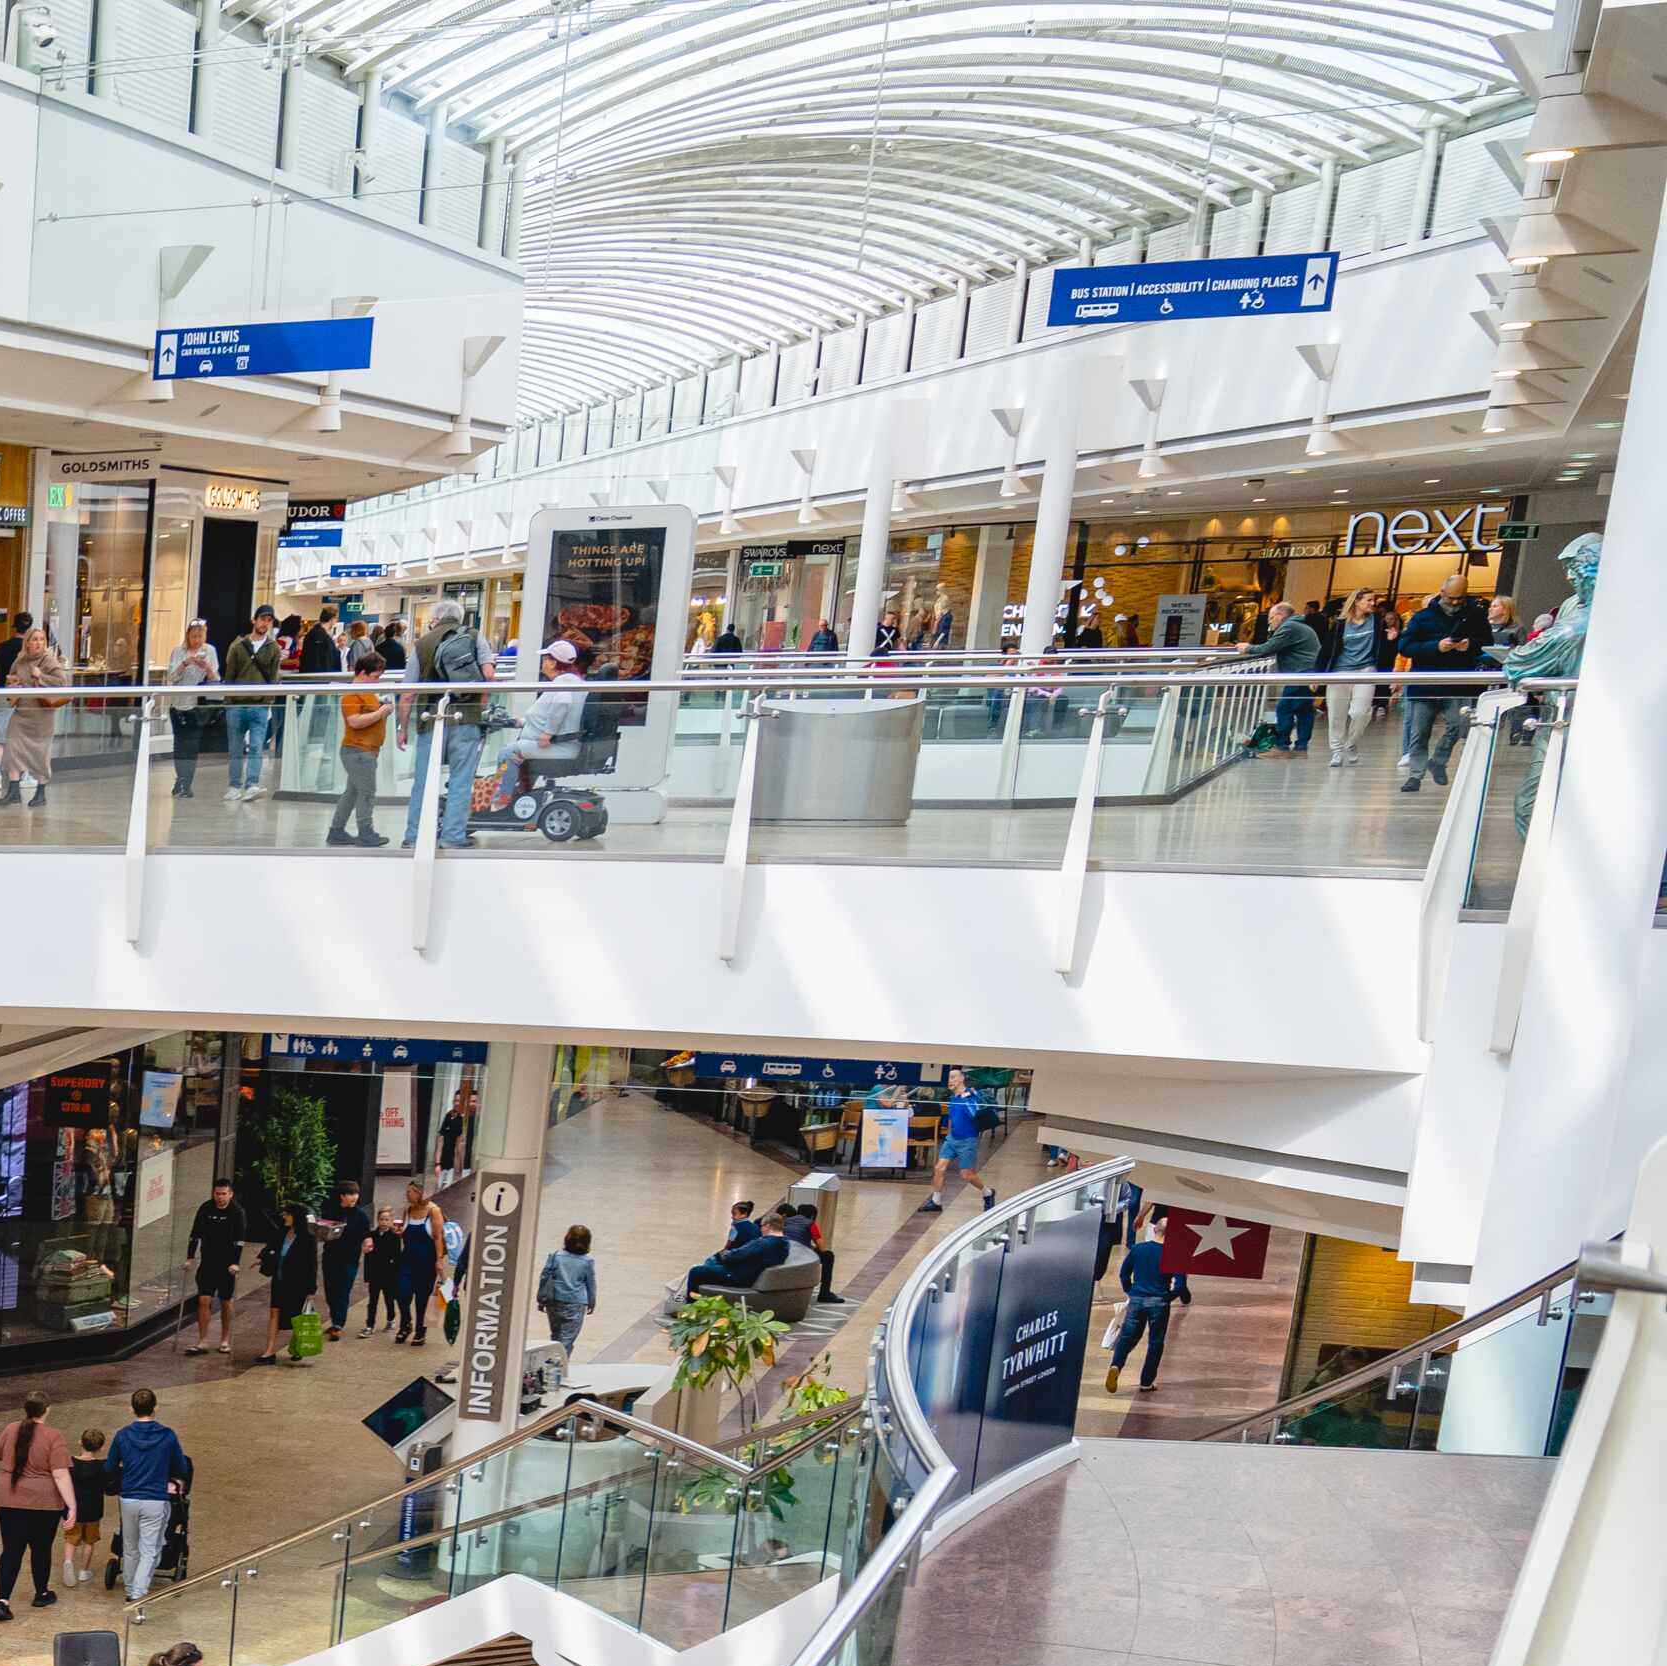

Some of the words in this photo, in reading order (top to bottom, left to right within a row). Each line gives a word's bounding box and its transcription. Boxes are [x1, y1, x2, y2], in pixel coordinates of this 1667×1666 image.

[1136, 281, 1204, 296] ACCESSIBILITY
[1212, 277, 1259, 290] CHANGING
[1261, 274, 1299, 288] PLACES
[1071, 288, 1090, 299] BUS
[1092, 285, 1128, 297] STATION
[182, 331, 206, 346] JOHN
[209, 329, 240, 344] LEWIS
[181, 348, 193, 357] CAR
[193, 347, 211, 356] PARKS
[61, 459, 151, 474] GOLDSMITHS
[288, 505, 331, 519] UDOR
[1346, 503, 1508, 557] next
[571, 545, 619, 555] THINGS
[619, 543, 645, 554] ARE
[743, 548, 787, 558] SWAROVS
[812, 543, 843, 554] next
[568, 558, 622, 568] HOTTING
[626, 557, 645, 567] UP!
[50, 1077, 107, 1089] SUPERDRY
[381, 1117, 405, 1128] THING
[467, 1225, 509, 1414] INFORMATION
[1015, 1310, 1058, 1343] CHARLES
[1002, 1330, 1068, 1380] TYRWHITT
